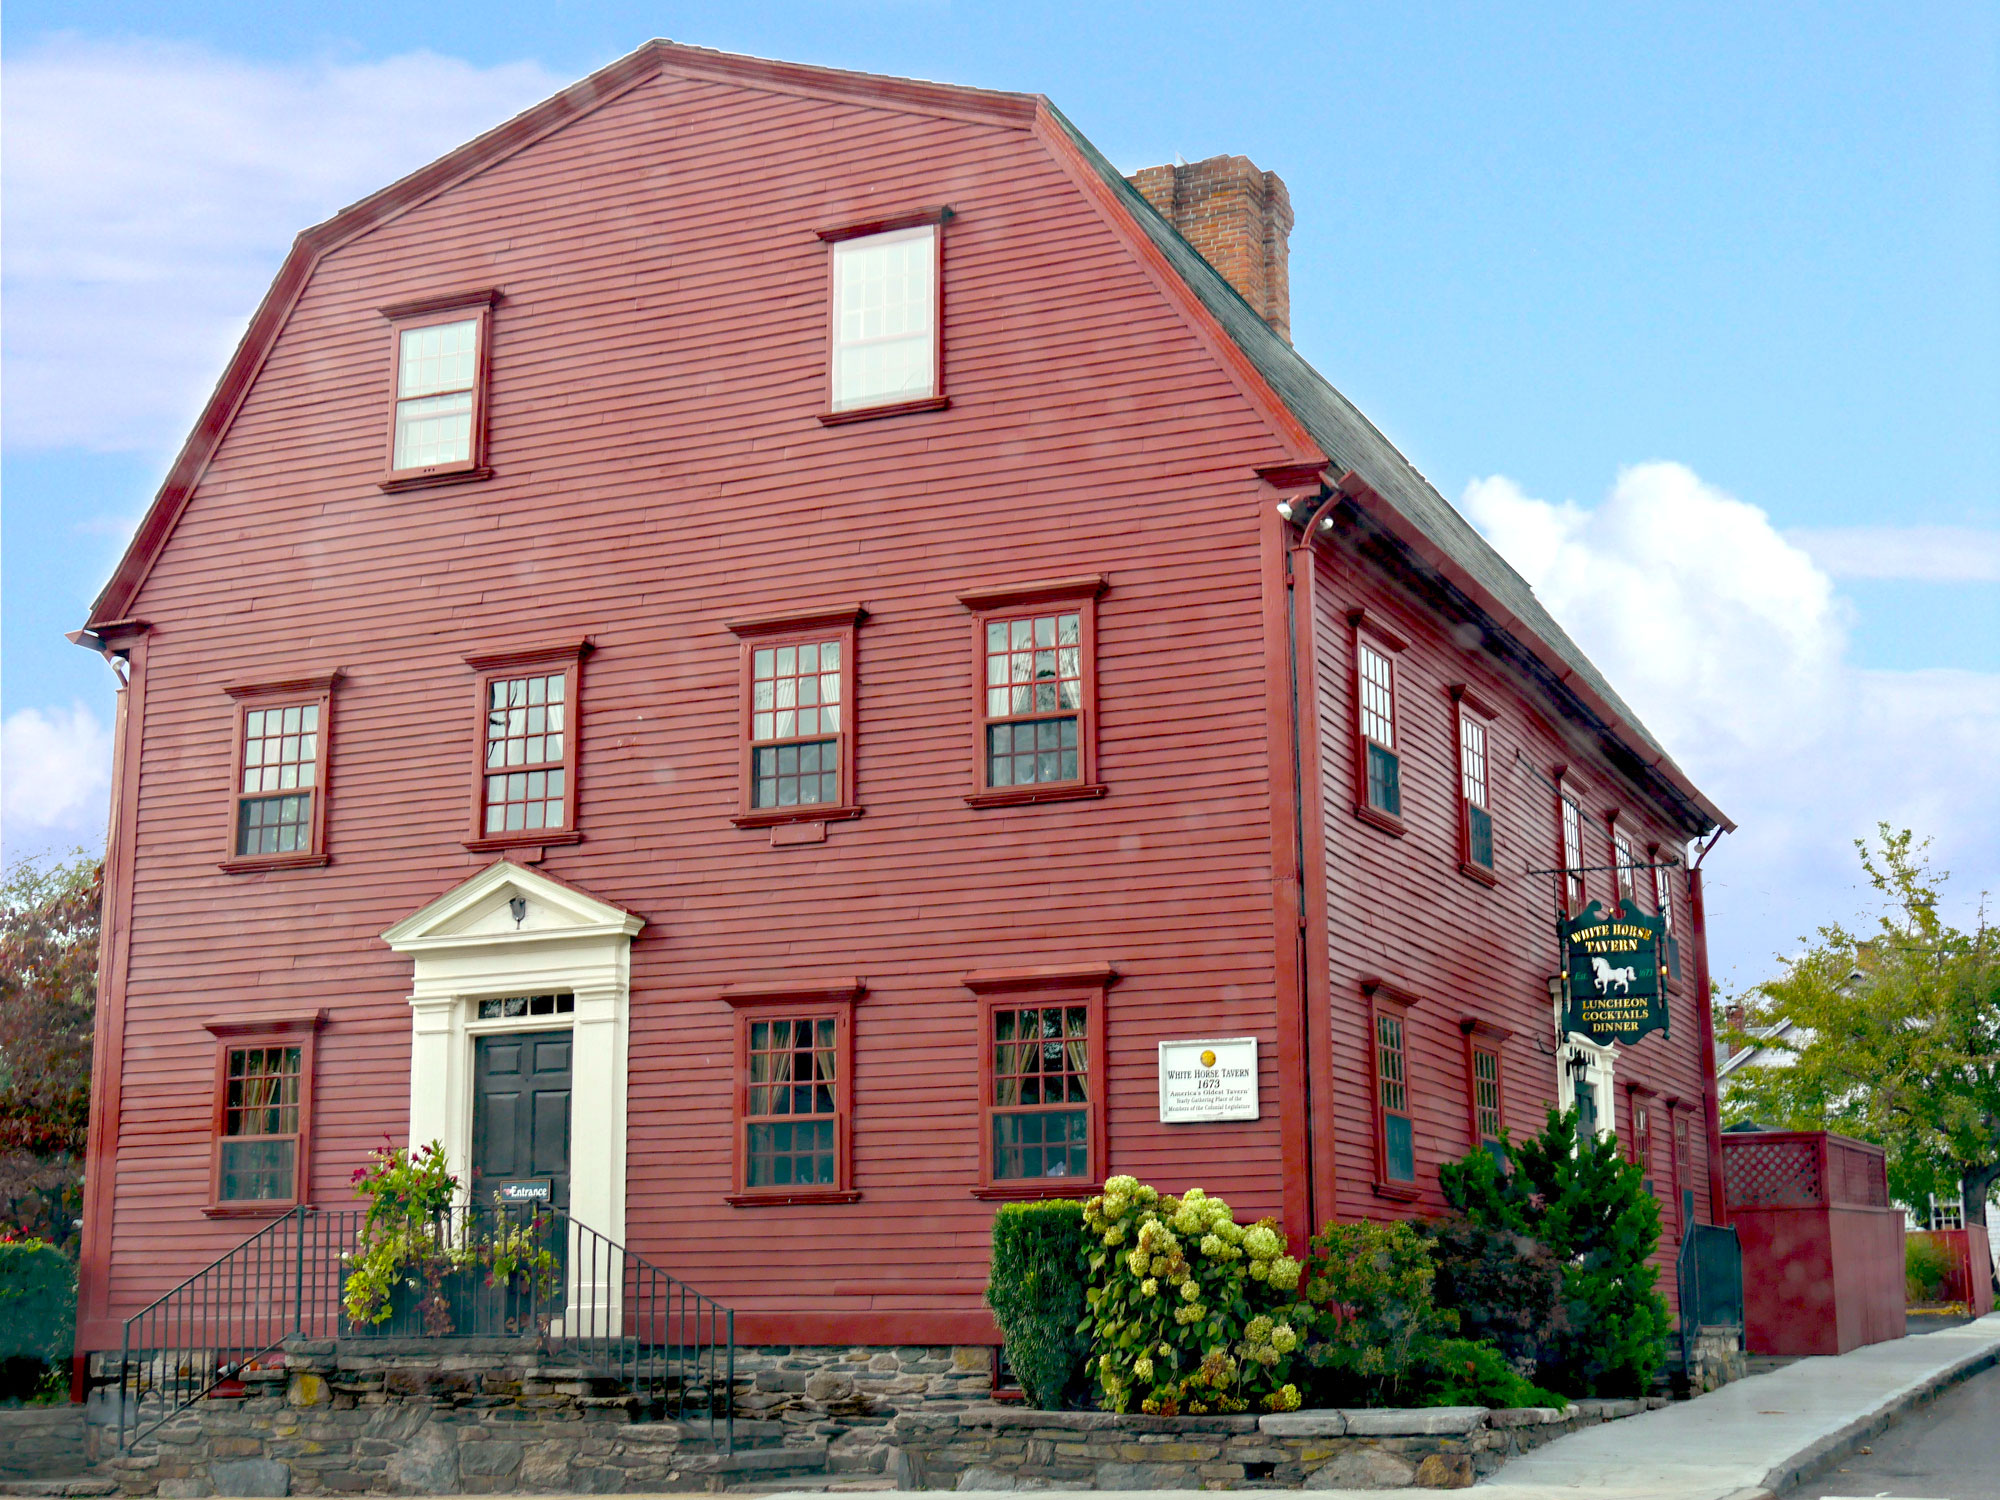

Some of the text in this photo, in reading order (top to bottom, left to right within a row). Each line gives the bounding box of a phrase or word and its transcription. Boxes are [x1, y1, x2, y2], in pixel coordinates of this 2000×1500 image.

[1571, 924, 1652, 943] WHITE HORSE
[1586, 939, 1638, 952] TAVERN
[1582, 998, 1648, 1010] LUNCHEON
[1582, 1009, 1649, 1021] COCKTAILS
[1593, 1021, 1639, 1033] DINNER
[1168, 1068, 1250, 1080] WHITE HORSE TAVERN
[1198, 1079, 1220, 1088] 1673
[511, 1186, 547, 1197] Entrance
